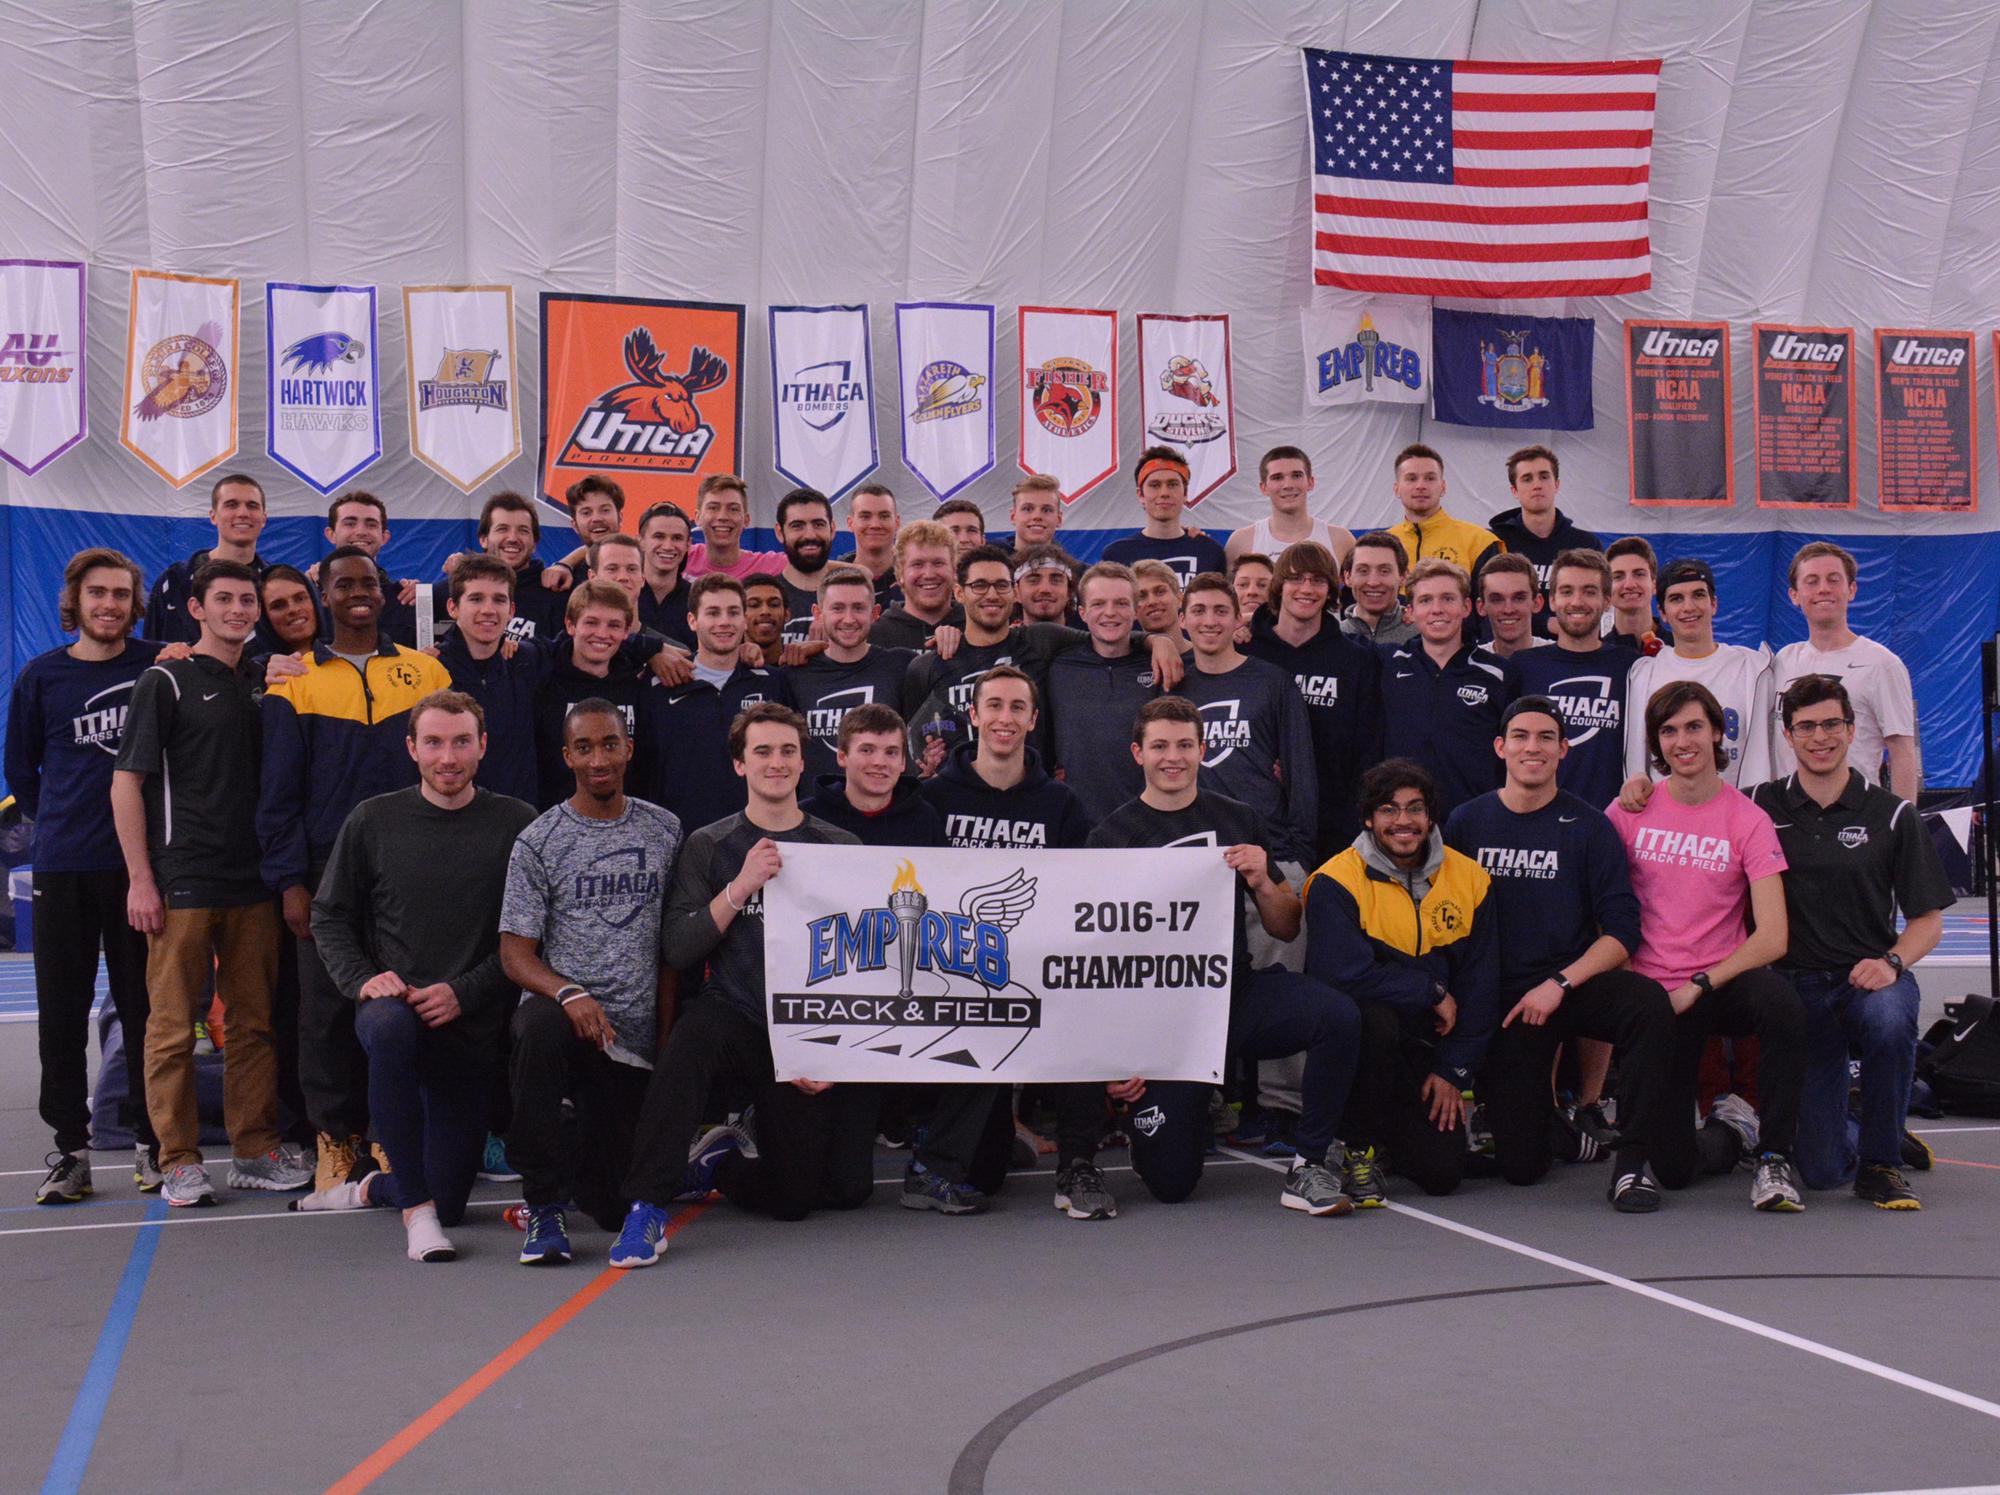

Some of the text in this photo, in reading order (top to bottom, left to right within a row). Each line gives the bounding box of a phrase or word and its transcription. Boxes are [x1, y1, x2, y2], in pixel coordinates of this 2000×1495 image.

[1642, 331, 1720, 357] UTICA
[1769, 335, 1845, 362] UTICA
[1891, 340, 1965, 366] UTICA
[1027, 368, 1109, 391] FISHER
[1655, 379, 1701, 400] NCAA
[281, 379, 367, 406] HARTWICK
[422, 383, 504, 407] HOUGHTON
[782, 383, 864, 402] ITHACA
[1781, 383, 1826, 404] NCAA
[1903, 387, 1947, 408] NCAA
[797, 403, 849, 411] BOMBERS
[280, 412, 369, 431] HAWKS
[576, 411, 711, 455] UTICA
[571, 454, 687, 466] PIONEERS
[804, 727, 840, 737] TRACK
[1569, 716, 1620, 729] COUNTRY
[75, 730, 114, 745] CROSS
[1209, 739, 1250, 748] & FIELD
[945, 814, 1047, 845] ITHACA
[951, 838, 988, 849] RACK
[1634, 827, 1731, 863] ITHACA
[1476, 847, 1559, 871] ITHACA
[1635, 850, 1728, 873] TRACK & FIELD
[575, 872, 659, 900] ITHACA
[1514, 869, 1523, 878] &
[1525, 869, 1557, 880] FIELD
[1074, 901, 1200, 933] 2016-17
[1042, 954, 1229, 990] CHAMPIONS
[780, 999, 1032, 1022] TRACK & FIELD
